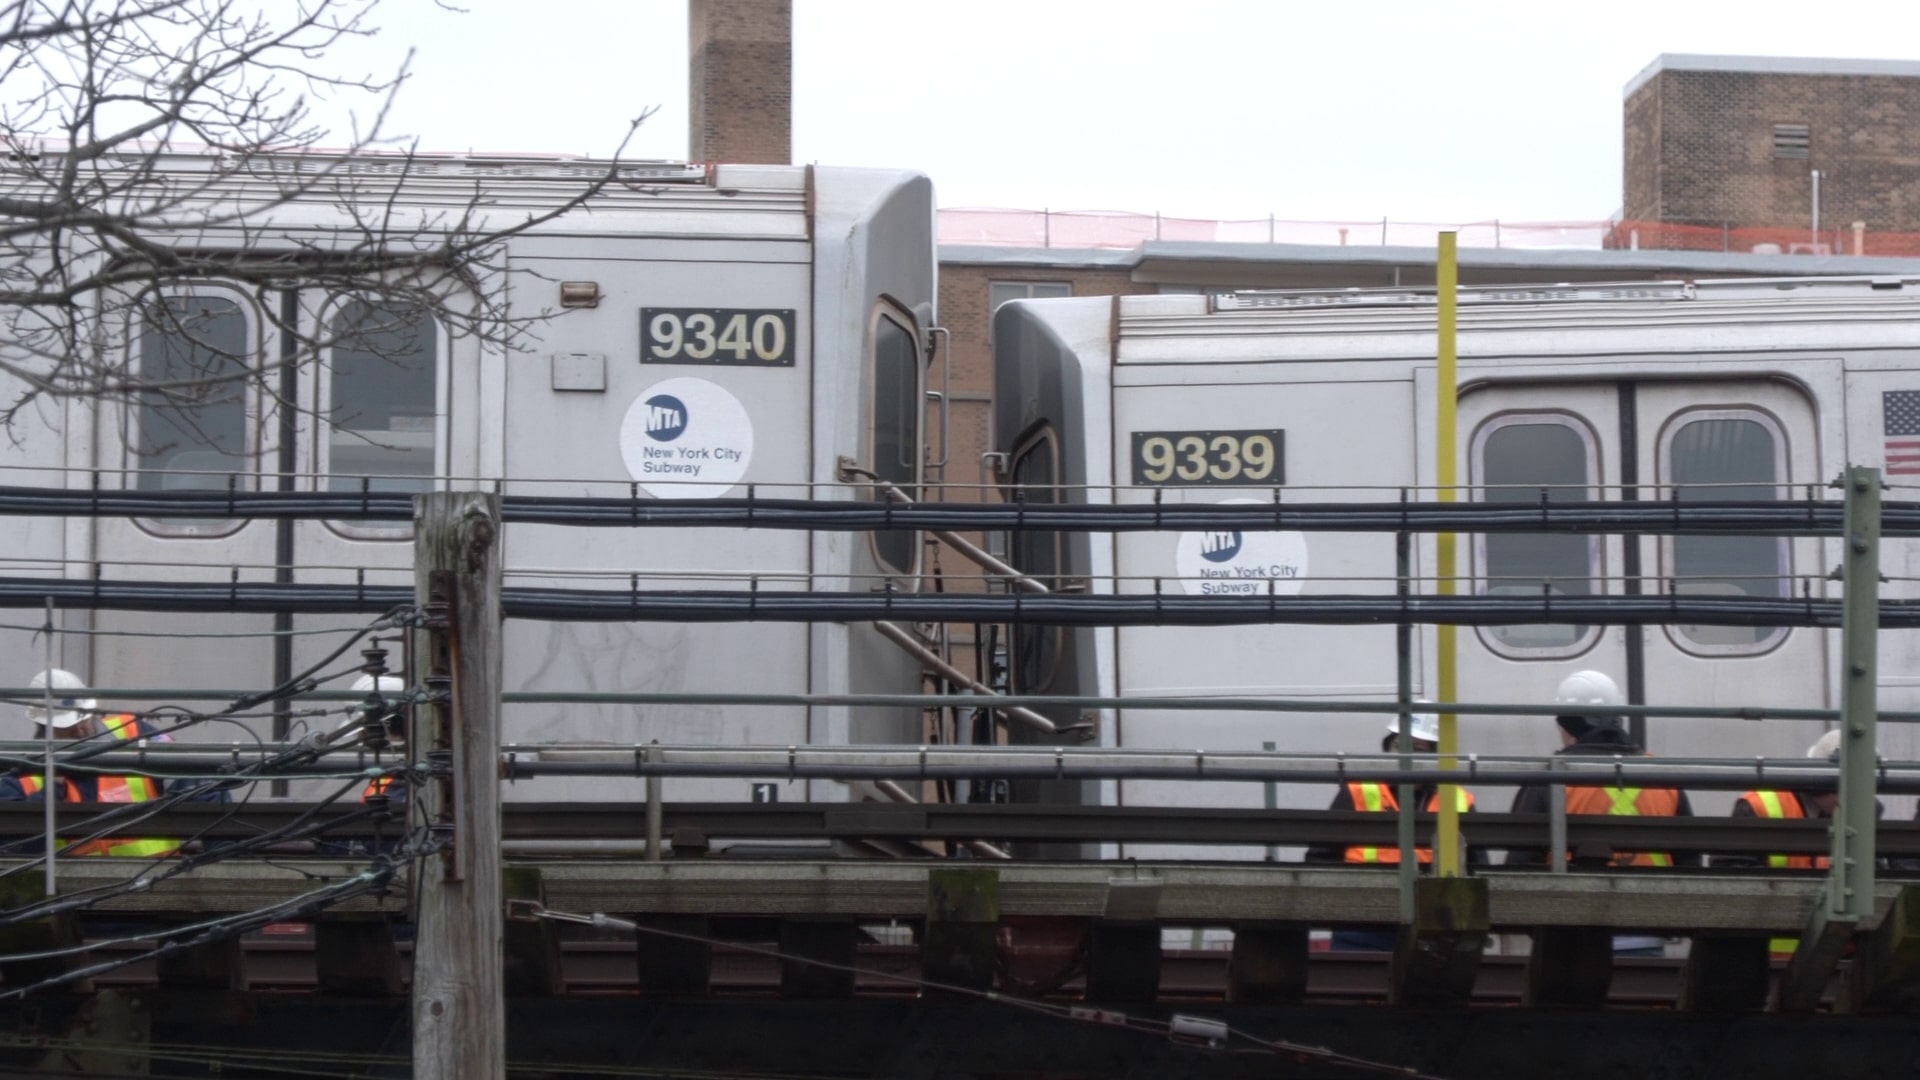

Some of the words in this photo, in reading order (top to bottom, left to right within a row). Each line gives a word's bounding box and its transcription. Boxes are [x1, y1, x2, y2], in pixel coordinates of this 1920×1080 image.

[650, 313, 786, 360] 9340
[645, 404, 681, 432] MTA
[643, 447, 673, 459] New
[677, 447, 710, 459] York
[713, 447, 742, 462] City
[1142, 435, 1274, 481] 9339
[643, 462, 701, 476] Subway
[1200, 531, 1236, 554] MTA
[1200, 568, 1230, 578] New
[1234, 566, 1266, 578] York
[1270, 564, 1298, 578] City
[1201, 582, 1258, 595] Subway
[758, 785, 770, 803] 1
